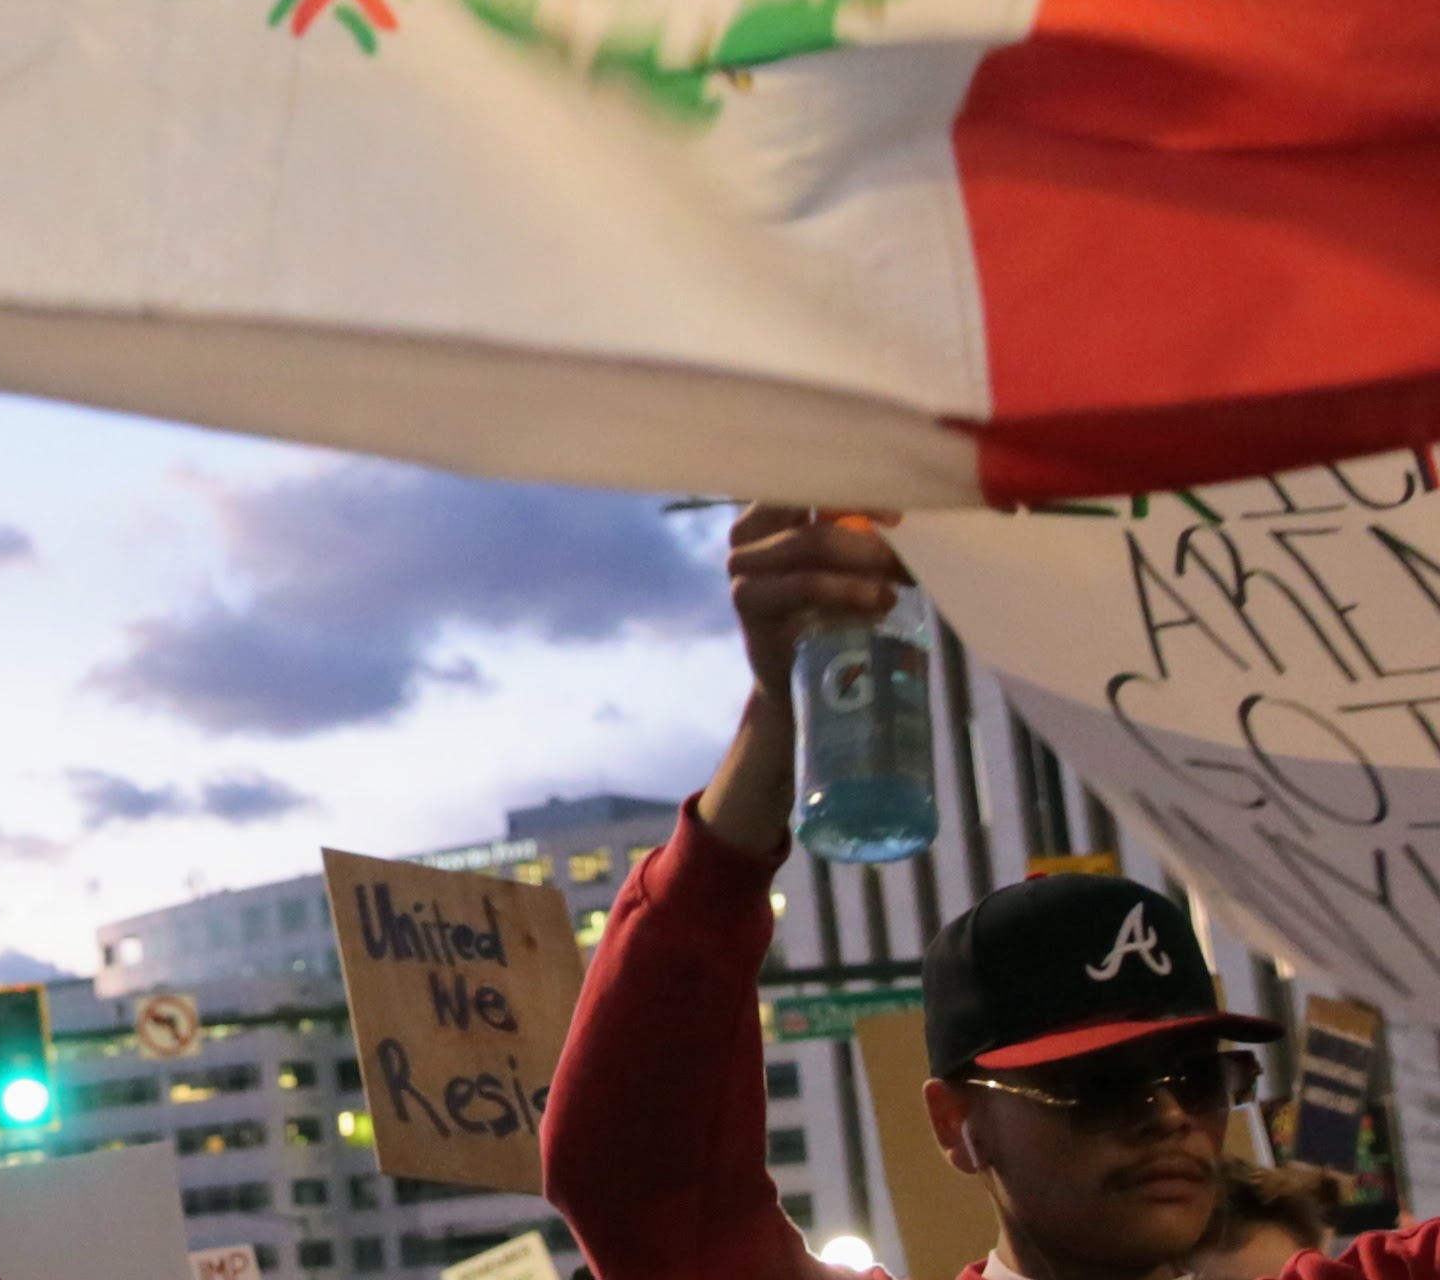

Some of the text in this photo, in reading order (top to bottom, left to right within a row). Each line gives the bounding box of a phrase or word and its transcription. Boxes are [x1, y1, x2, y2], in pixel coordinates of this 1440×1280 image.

[355, 883, 508, 967] United
[1086, 901, 1172, 982] A
[428, 972, 518, 1032] We
[377, 1038, 551, 1138] Resi
